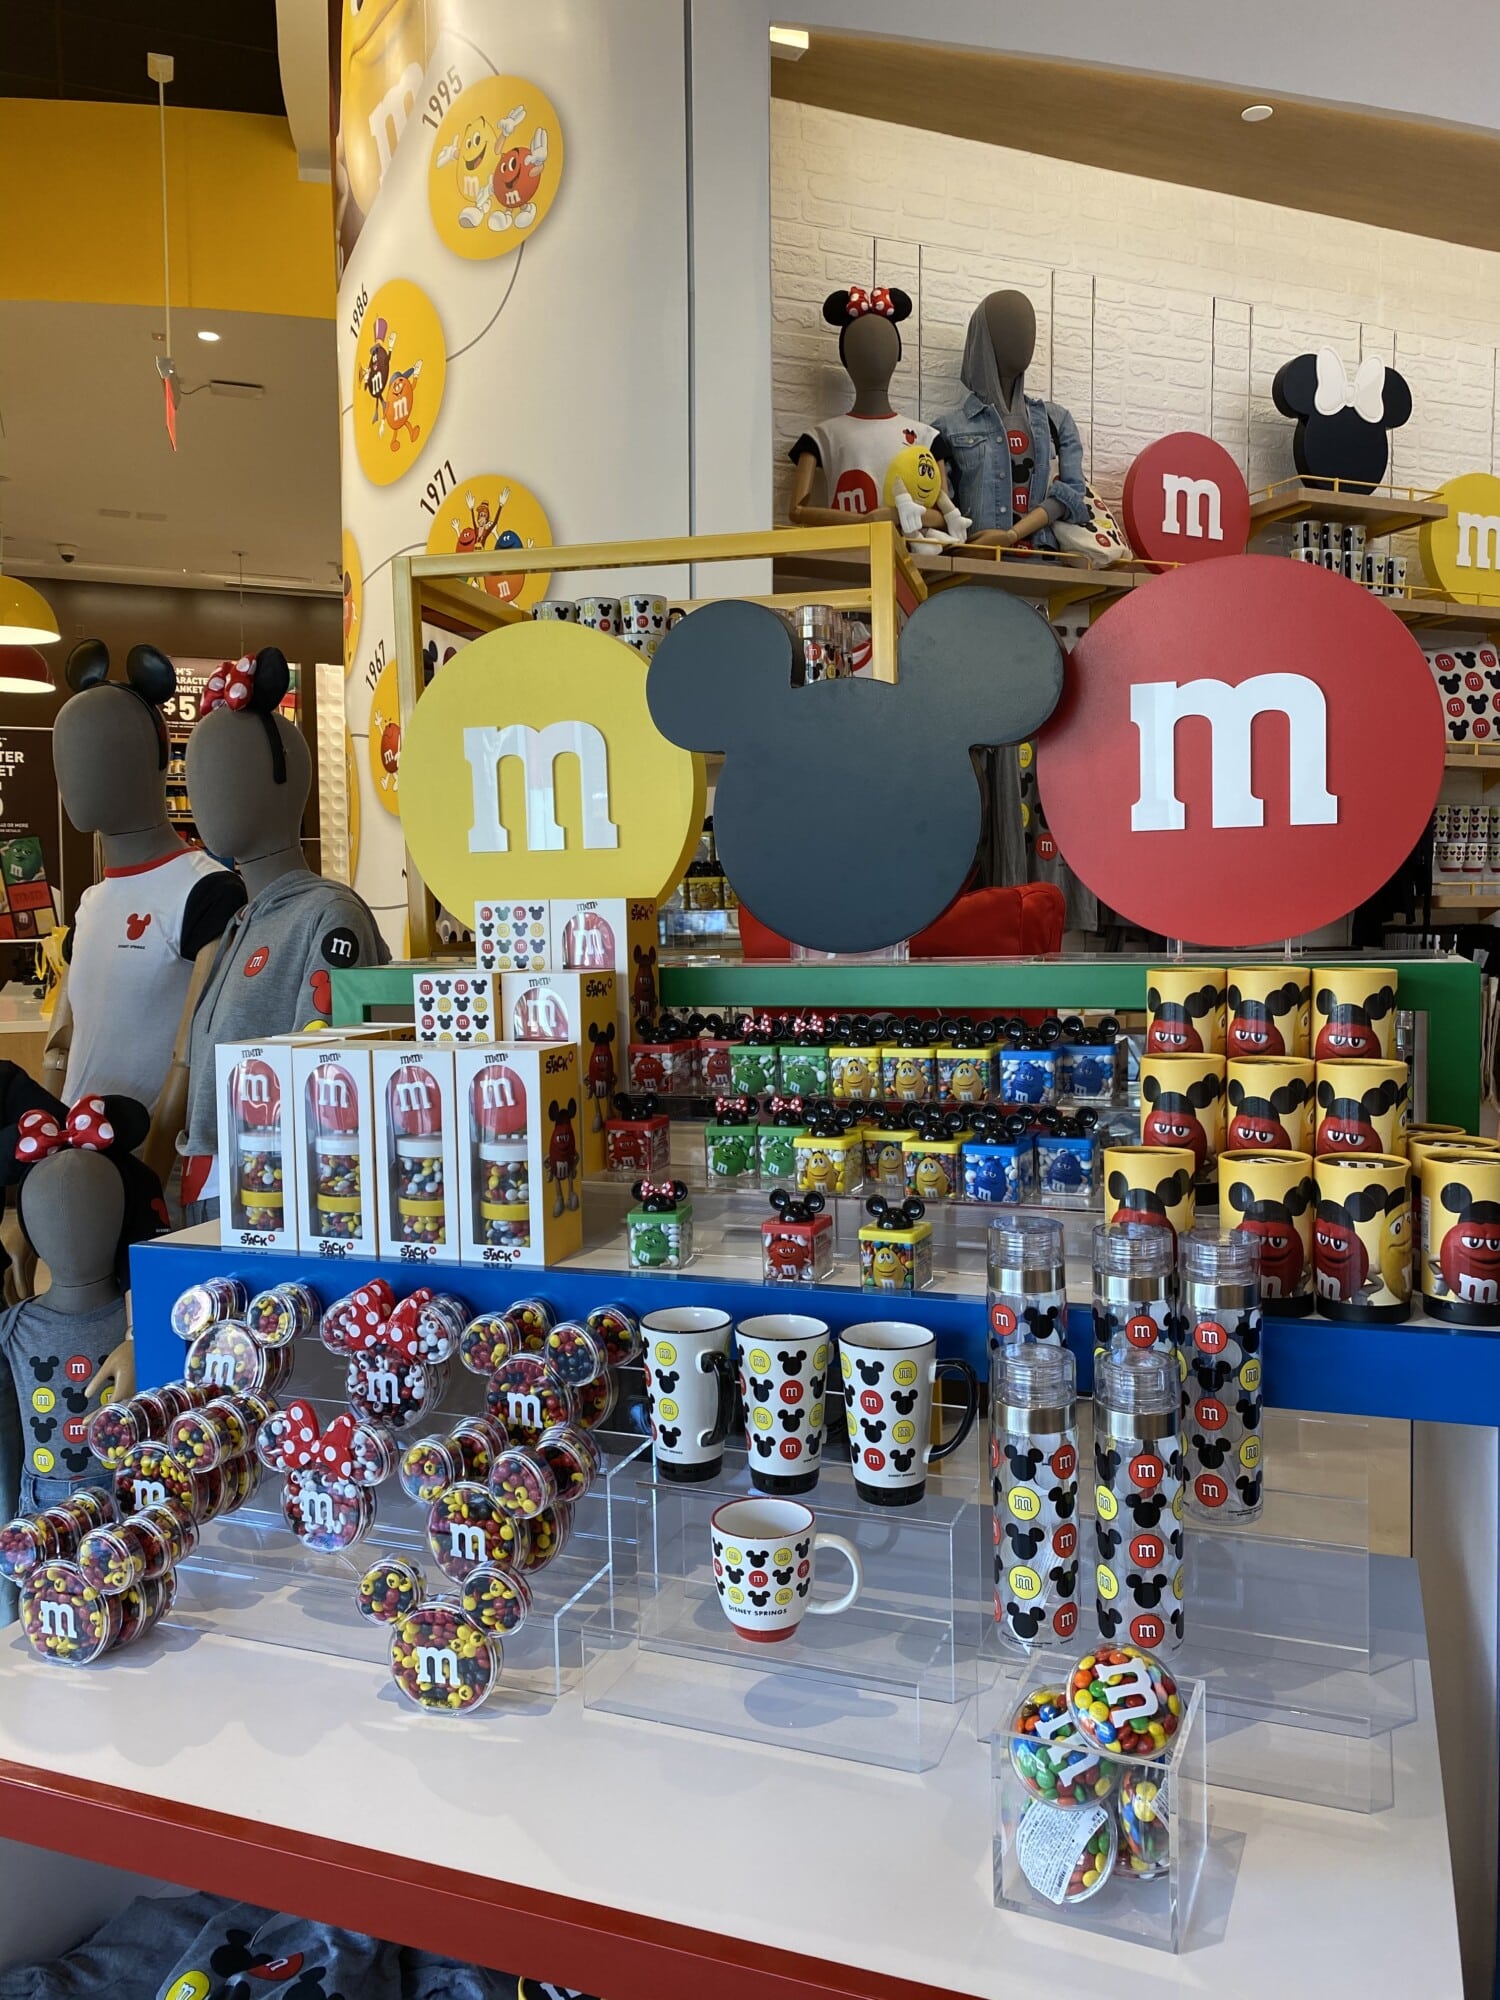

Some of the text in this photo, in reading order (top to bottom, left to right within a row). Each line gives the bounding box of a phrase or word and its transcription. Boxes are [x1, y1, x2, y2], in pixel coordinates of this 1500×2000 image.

[422, 65, 463, 129] 1995
[463, 175, 480, 197] m
[505, 190, 521, 205] m
[350, 283, 369, 339] 1986
[371, 372, 383, 395] m
[393, 396, 409, 421] m
[1010, 437, 1022, 447] m
[419, 459, 457, 516] 1971
[837, 487, 867, 514] m
[1016, 494, 1026, 504] m
[1161, 472, 1223, 541] m
[1456, 511, 1500, 569] m
[497, 580, 511, 598] m
[365, 639, 386, 691] 1967
[384, 749, 394, 765] m
[1130, 672, 1337, 831] m
[463, 720, 619, 853] m
[1042, 841, 1052, 852] m
[331, 938, 352, 958] m
[250, 956, 262, 968] m
[240, 1073, 270, 1102] m
[644, 1079, 656, 1089] m
[716, 1075, 728, 1085] m
[739, 1081, 749, 1092] m
[790, 1082, 800, 1092] m
[318, 1077, 349, 1108] m
[396, 1080, 432, 1112] m
[480, 1077, 515, 1109] m
[1015, 1090, 1028, 1103] m
[1074, 1085, 1087, 1095] m
[556, 1161, 568, 1177] m
[622, 1157, 634, 1166] m
[717, 1163, 727, 1174] m
[769, 1163, 779, 1174] m
[978, 1187, 991, 1199] m
[1052, 1180, 1065, 1192] m
[240, 1233, 268, 1246] STACK
[319, 1240, 346, 1255] STACK
[400, 1245, 428, 1260] STACK
[483, 1248, 512, 1262] STACK
[639, 1250, 650, 1263] m
[781, 1264, 796, 1275] m
[1316, 1267, 1341, 1301] m
[1458, 1272, 1500, 1304] m
[995, 1312, 1009, 1327] m
[1134, 1325, 1151, 1338] m
[1202, 1331, 1219, 1345] m
[72, 1363, 85, 1374] m
[205, 1352, 235, 1386] m
[1247, 1367, 1259, 1382] m
[366, 1371, 401, 1404] m
[786, 1386, 798, 1397] m
[37, 1394, 50, 1405] m
[866, 1396, 878, 1407] m
[507, 1391, 543, 1429] m
[1202, 1406, 1219, 1421] m
[70, 1424, 84, 1435] m
[785, 1443, 797, 1454] m
[1246, 1444, 1258, 1458] m
[38, 1454, 49, 1466] m
[868, 1454, 880, 1464] m
[1059, 1453, 1072, 1469] m
[1137, 1463, 1156, 1478] m
[134, 1478, 166, 1511] m
[1202, 1483, 1219, 1498] m
[299, 1490, 334, 1527] m
[1014, 1495, 1033, 1511] m
[1099, 1497, 1111, 1513] m
[449, 1521, 488, 1562] m
[1060, 1532, 1073, 1547] m
[1138, 1543, 1156, 1558] m
[753, 1575, 764, 1583] m
[1015, 1574, 1034, 1590] m
[1099, 1575, 1112, 1592] m
[728, 1604, 787, 1616] DISNEY SPRINGS
[41, 1599, 78, 1640] m
[1061, 1611, 1074, 1627] m
[1138, 1622, 1157, 1638] m
[416, 1646, 461, 1685] m
[1095, 1657, 1158, 1728] m
